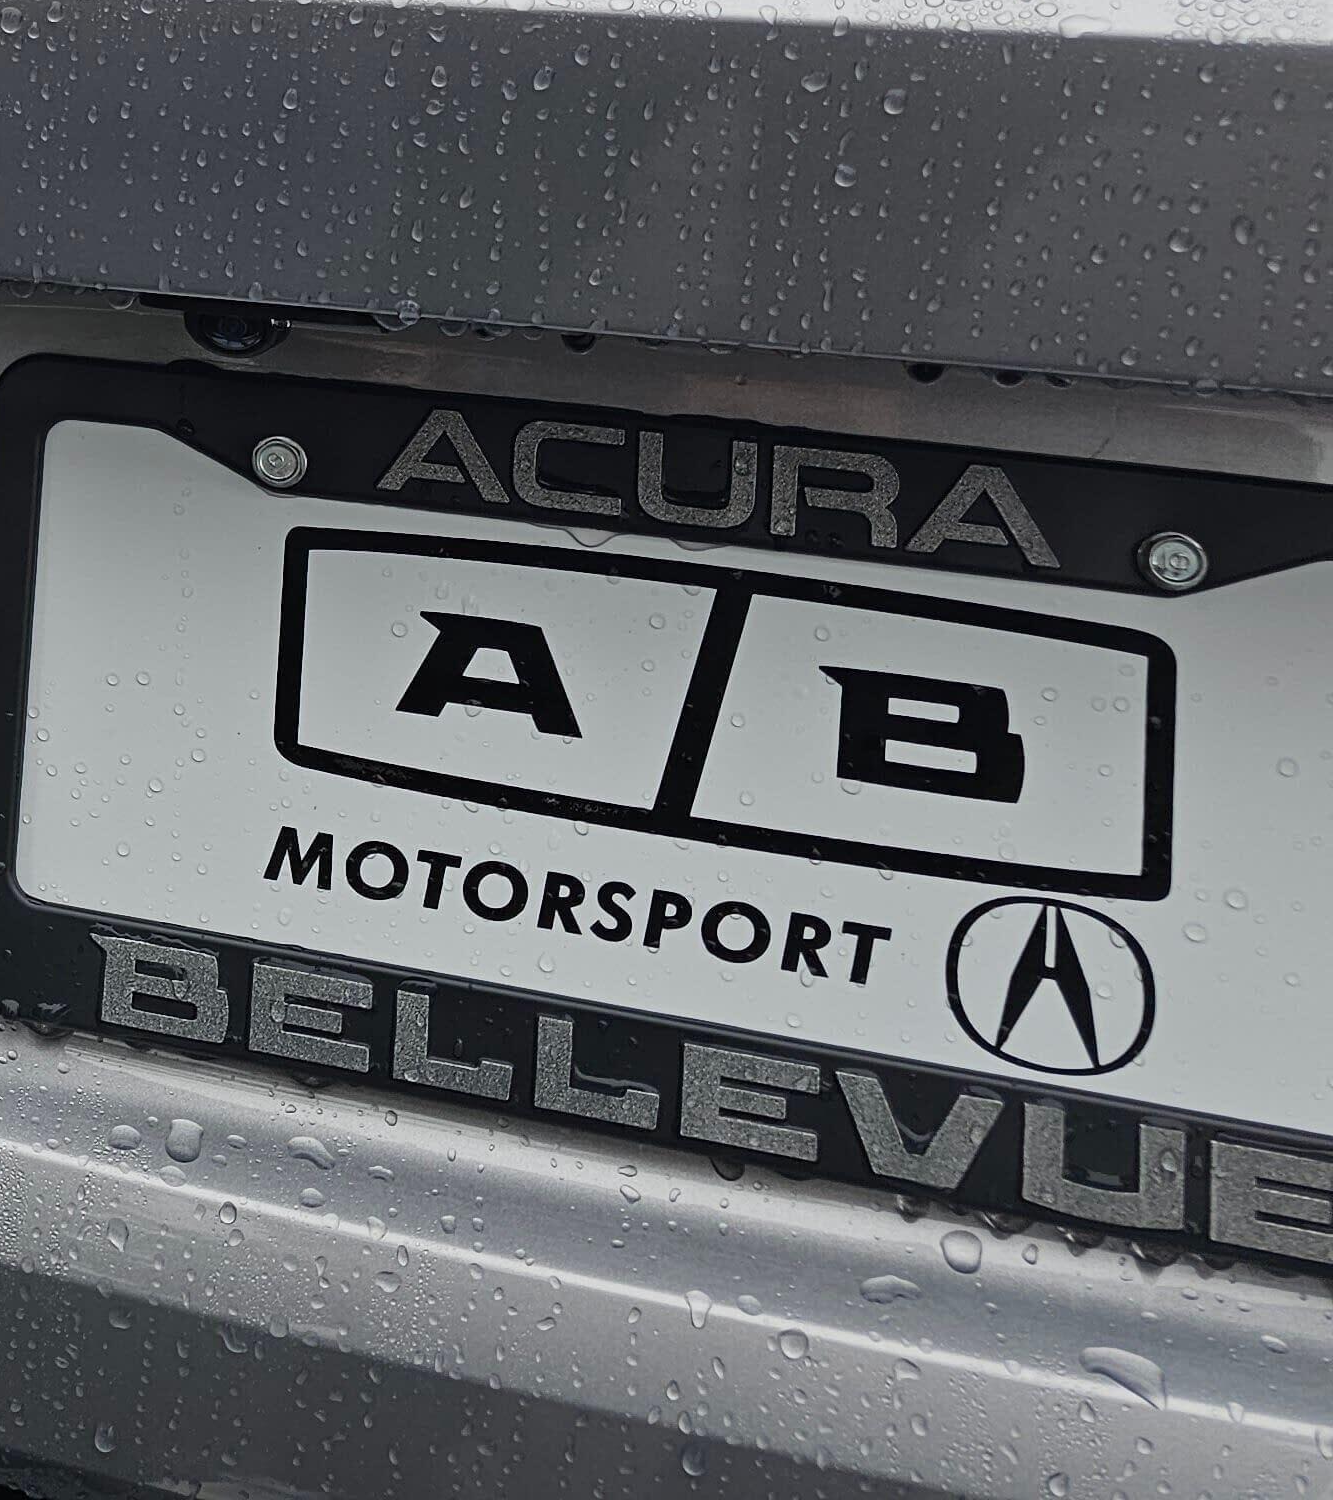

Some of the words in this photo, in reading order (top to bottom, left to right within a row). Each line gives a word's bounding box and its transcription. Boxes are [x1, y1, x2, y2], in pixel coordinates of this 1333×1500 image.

[376, 407, 1062, 569] ACURA
[395, 610, 583, 739] A
[818, 665, 1026, 804] B
[263, 826, 893, 985] MOTORSPORT
[89, 930, 1333, 1266] BELLEVUE
